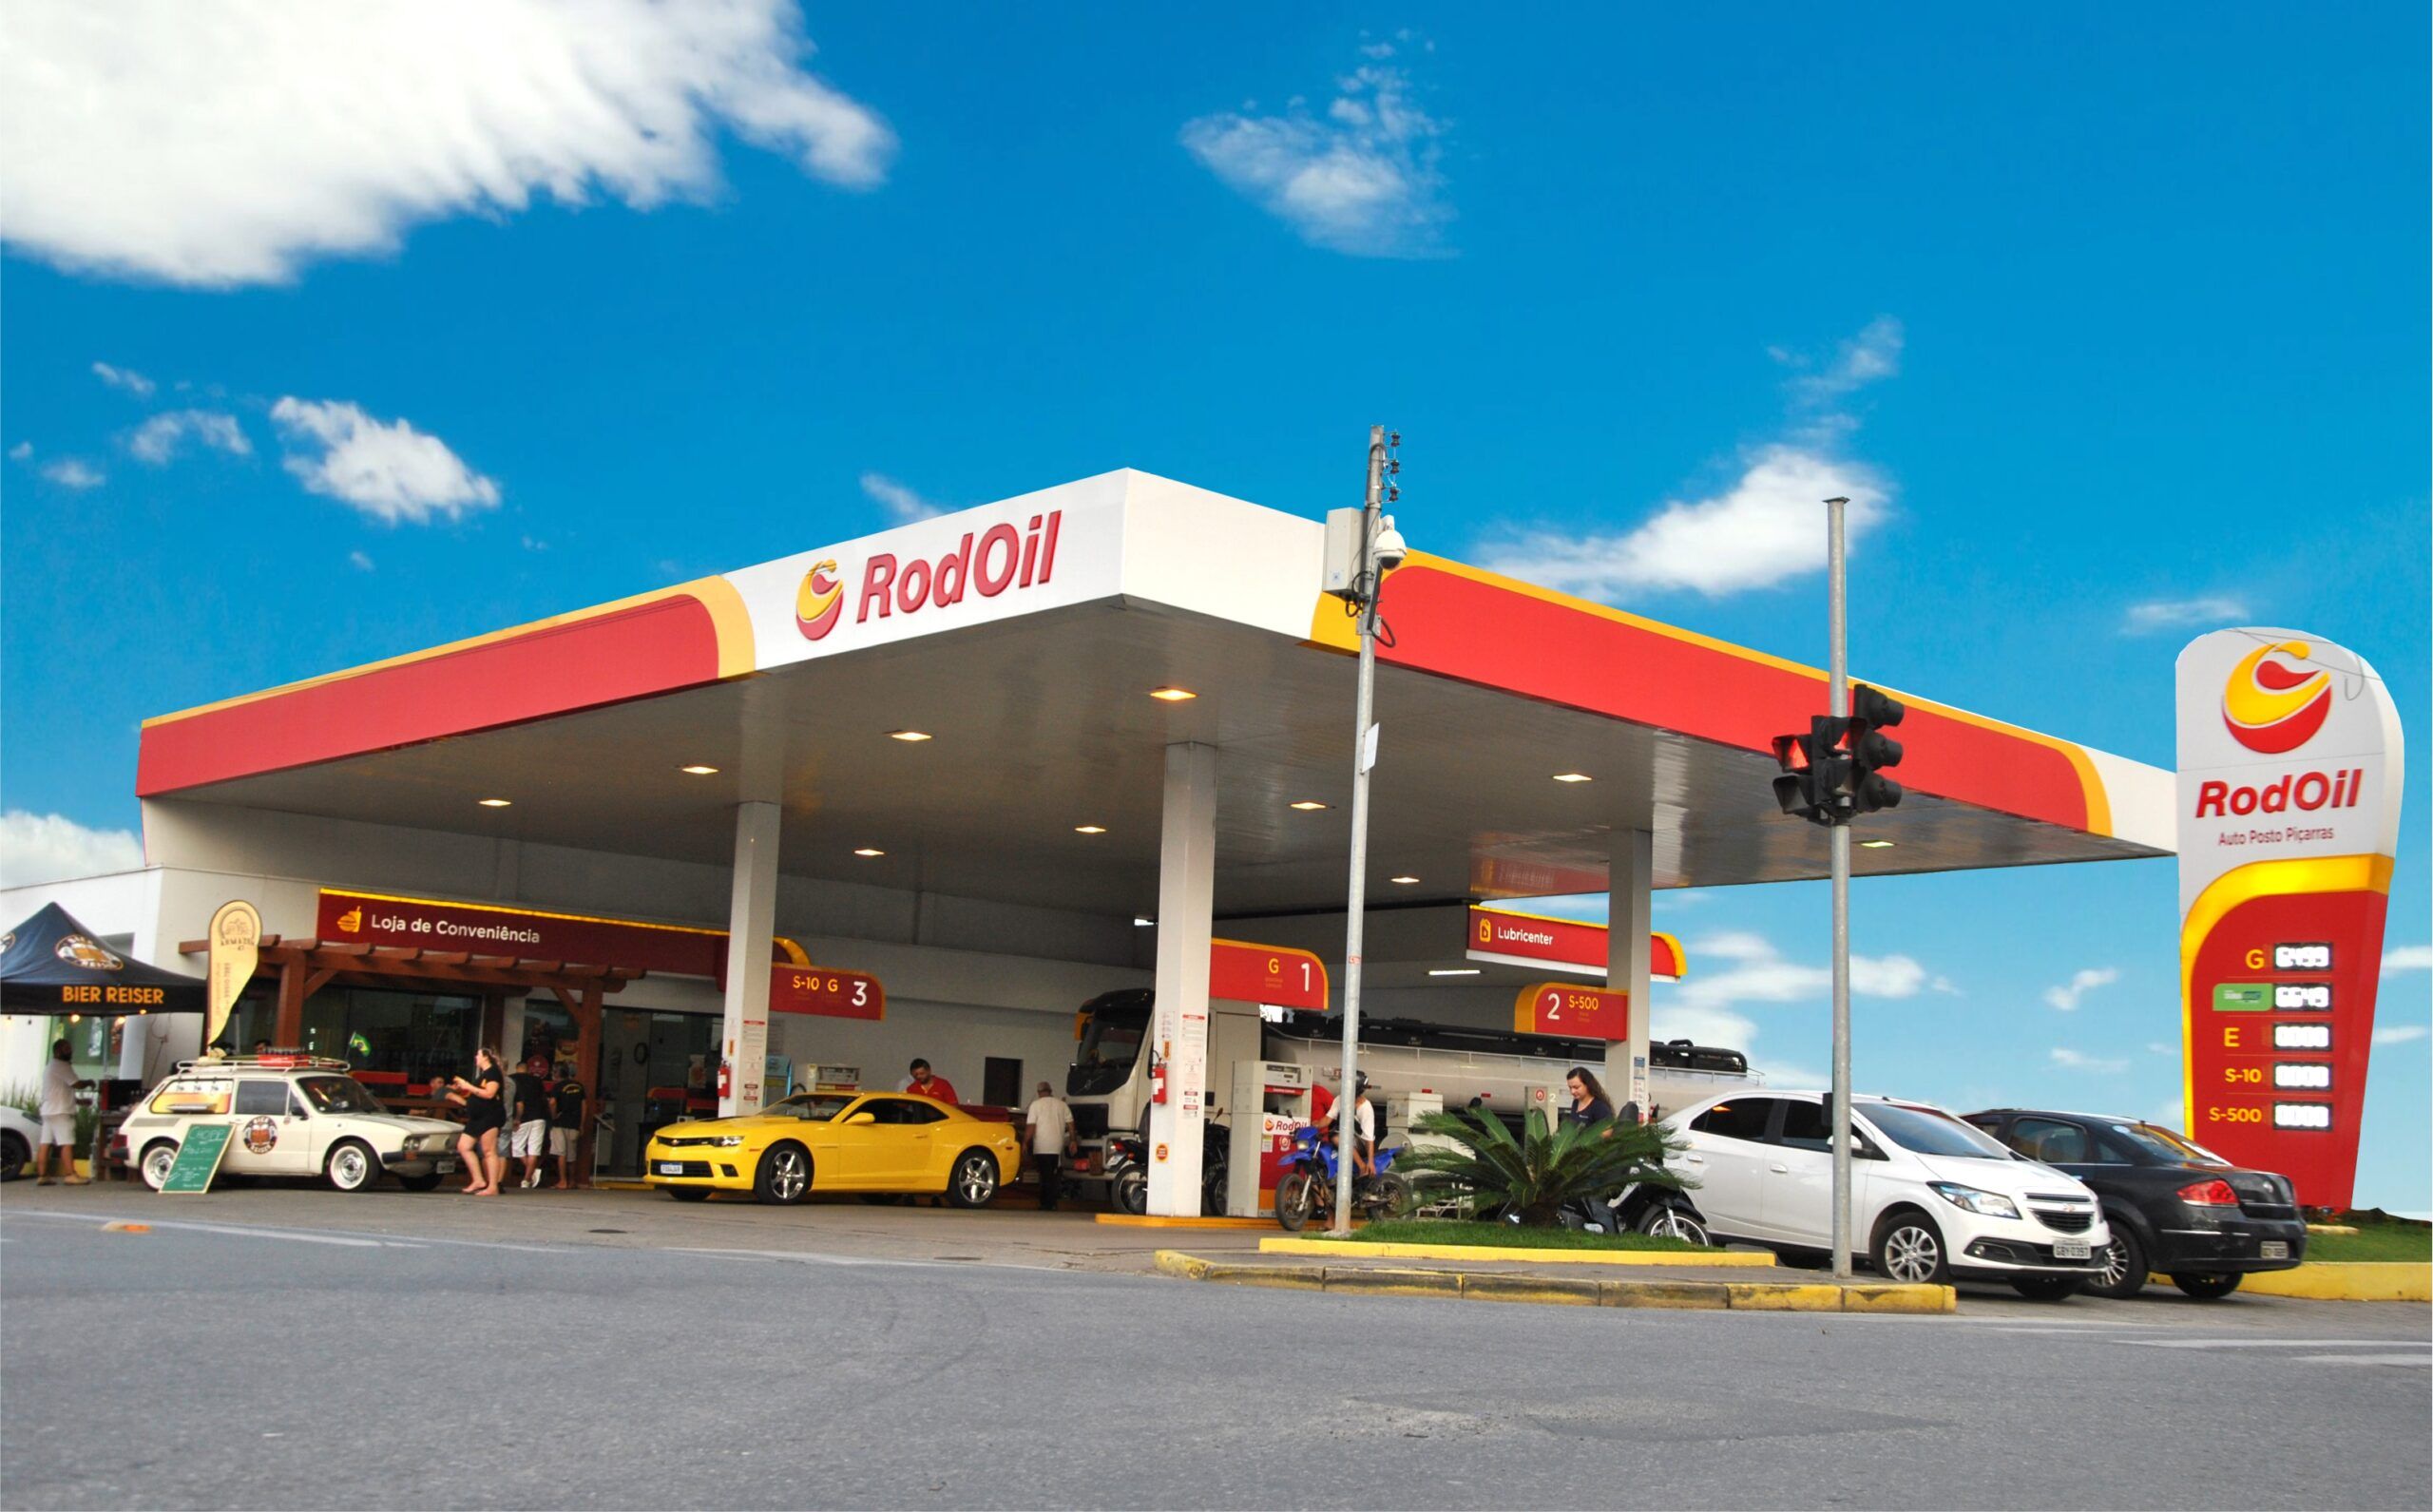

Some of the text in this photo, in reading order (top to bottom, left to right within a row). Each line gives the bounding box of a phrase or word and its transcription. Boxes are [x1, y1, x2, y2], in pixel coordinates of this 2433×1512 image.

[856, 509, 1063, 623] RodOil
[2195, 769, 2364, 818] RodOil
[2218, 826, 2334, 846] Auto Posto Piçarras
[371, 914, 540, 944] Loja de Conveniência
[1498, 926, 1554, 946] Lubricenter
[1268, 957, 1279, 974] G
[2245, 948, 2266, 969] G
[793, 975, 838, 992] S-10 G
[1300, 962, 1311, 992] 1
[62, 986, 164, 1005] BIER REISER
[851, 981, 868, 1007] 3
[1547, 992, 1561, 1021] 2
[1568, 994, 1600, 1011] S-500
[2224, 1027, 2241, 1047] E
[2224, 1068, 2263, 1083] S-10
[2209, 1106, 2263, 1123] S-500
